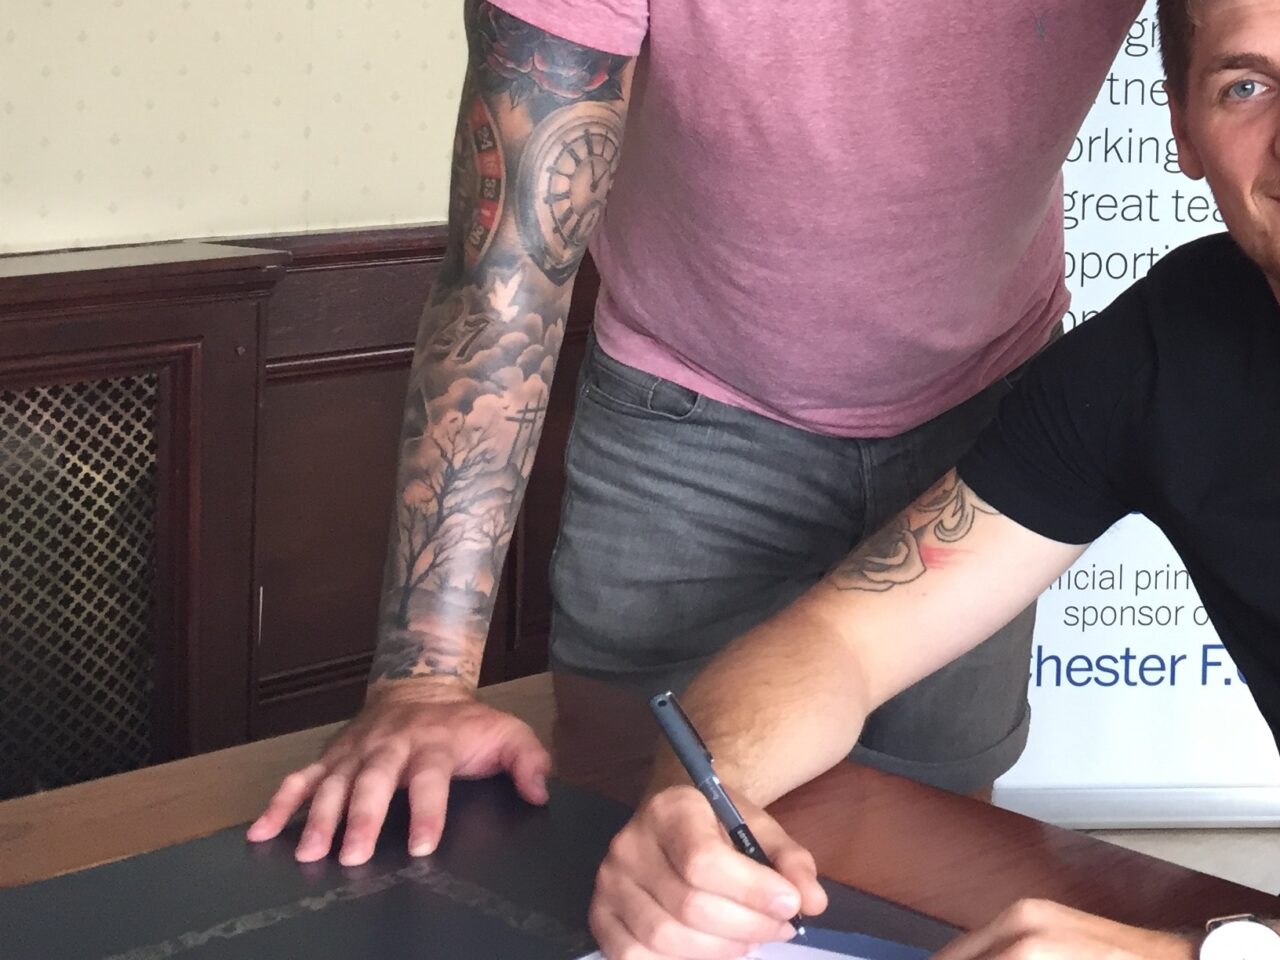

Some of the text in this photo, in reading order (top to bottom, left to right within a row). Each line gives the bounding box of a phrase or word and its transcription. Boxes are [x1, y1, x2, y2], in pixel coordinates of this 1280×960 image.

[1105, 72, 1169, 106] tne
[1066, 127, 1183, 174] orking
[1064, 189, 1160, 230] great
[1064, 245, 1169, 288] port
[1050, 563, 1124, 591] icial
[1063, 605, 1185, 632] sponsor
[1033, 643, 1247, 687] hester F.
